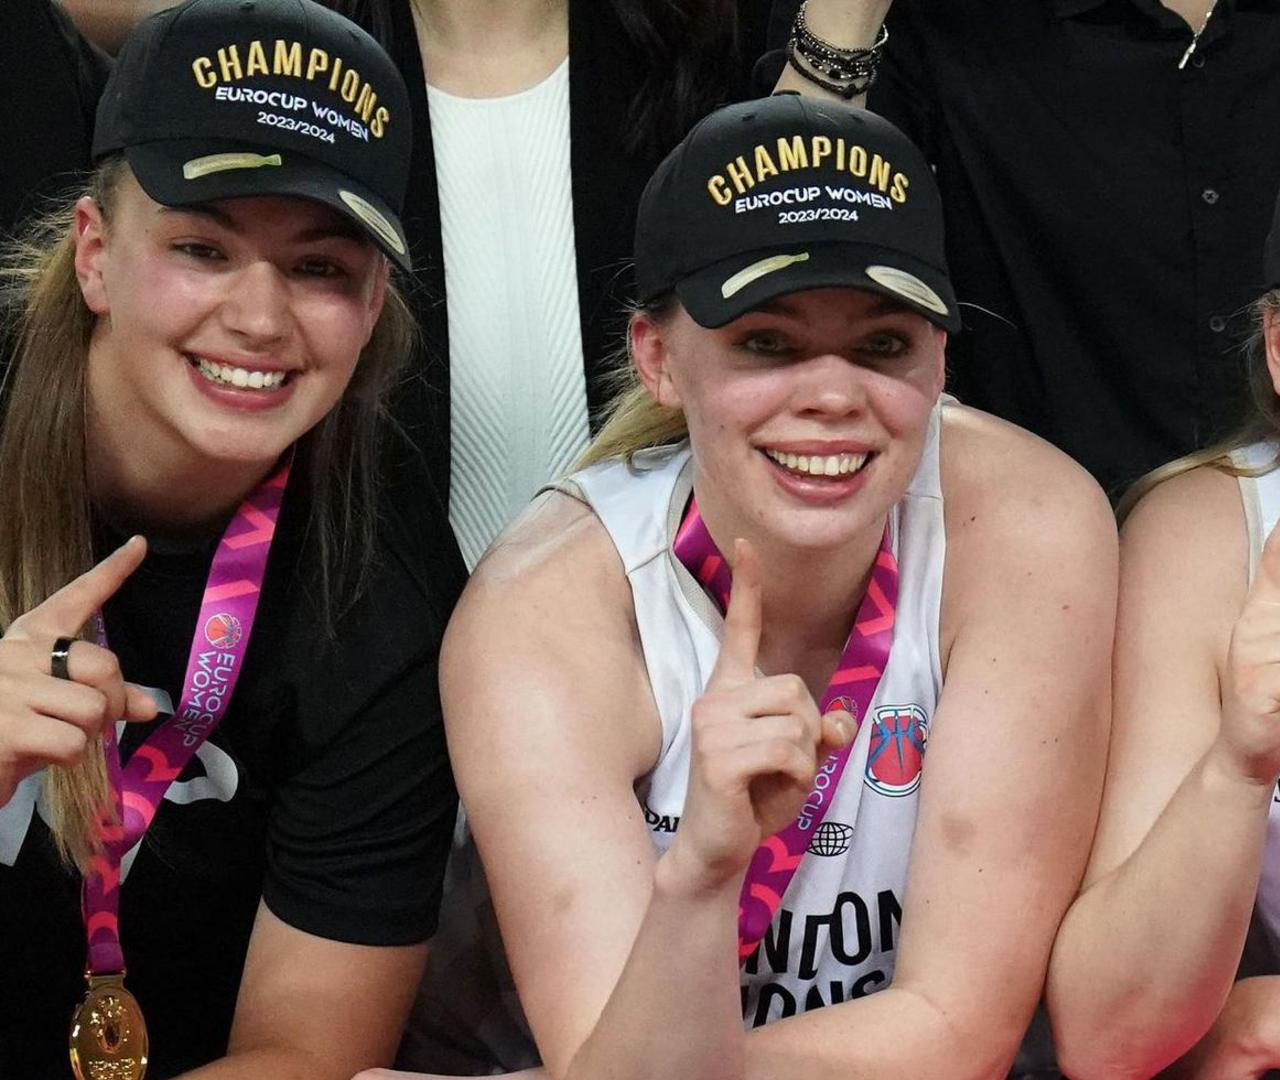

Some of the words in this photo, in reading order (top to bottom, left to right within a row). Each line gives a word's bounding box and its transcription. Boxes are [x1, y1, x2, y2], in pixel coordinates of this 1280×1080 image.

[192, 39, 390, 139] CHAMPIONS
[216, 86, 307, 111] EUROCUP
[312, 103, 369, 142] WOMEN
[257, 111, 336, 144] 2023/2024
[707, 135, 910, 206] CHAMPIONS
[735, 187, 821, 213] EUROCUP
[825, 186, 893, 210] WOMEN
[778, 208, 858, 224] 2023/2024
[173, 650, 216, 731] WOMEN
[183, 653, 235, 746] EUROCUP
[797, 755, 839, 831] ROCUP
